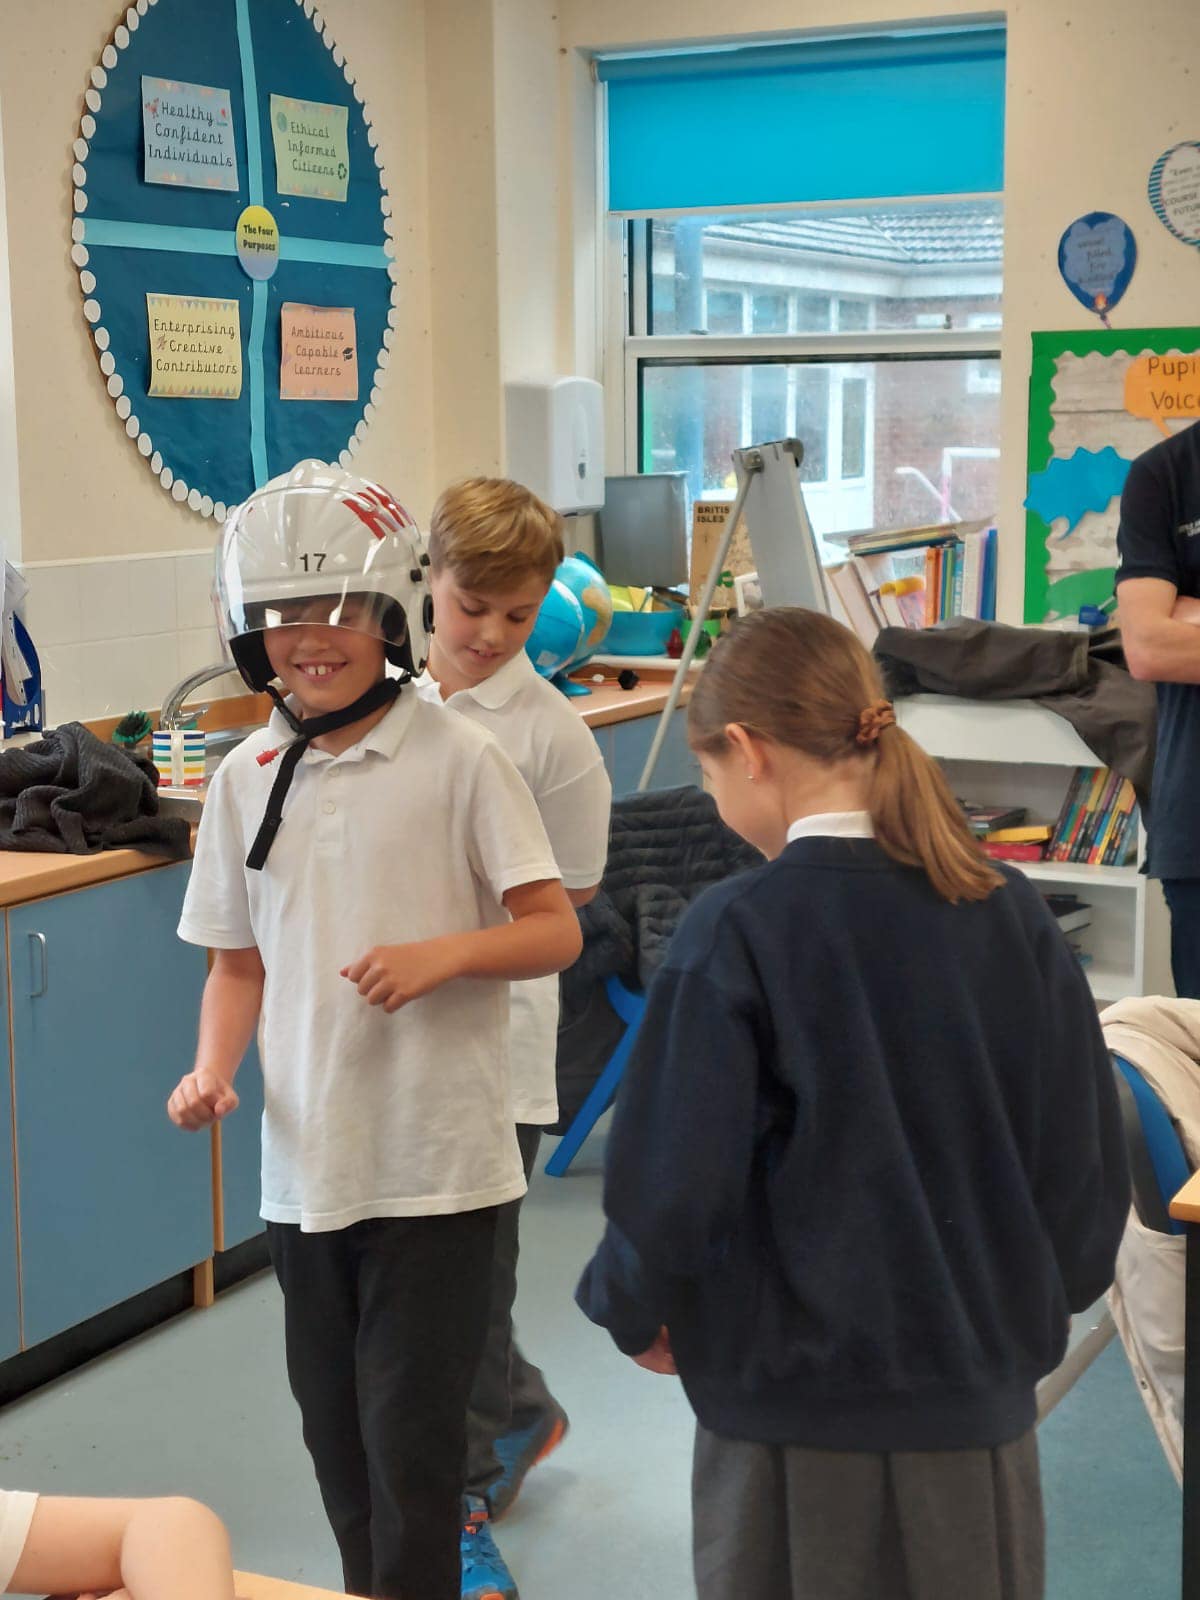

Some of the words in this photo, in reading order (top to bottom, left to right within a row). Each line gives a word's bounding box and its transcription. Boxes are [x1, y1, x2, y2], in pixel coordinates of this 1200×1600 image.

[161, 101, 214, 127] Healthy
[155, 122, 224, 145] Confident
[290, 121, 330, 139] Ethical
[148, 143, 233, 168] Individuals
[288, 139, 337, 158] Informed
[292, 158, 335, 177] Citizens
[243, 224, 257, 234] The
[258, 225, 274, 236] Four
[243, 239, 276, 252] Purposes
[154, 318, 235, 340] Enterprising
[291, 326, 345, 341] Ambitious
[169, 339, 224, 354] Creative
[295, 344, 339, 361] Capable
[156, 358, 238, 374] Contributors
[294, 362, 342, 377] Learners
[1148, 356, 1197, 382] Pupi
[697, 505, 731, 515] BRITIS
[696, 514, 726, 524] ISLES
[299, 553, 327, 572] 17
